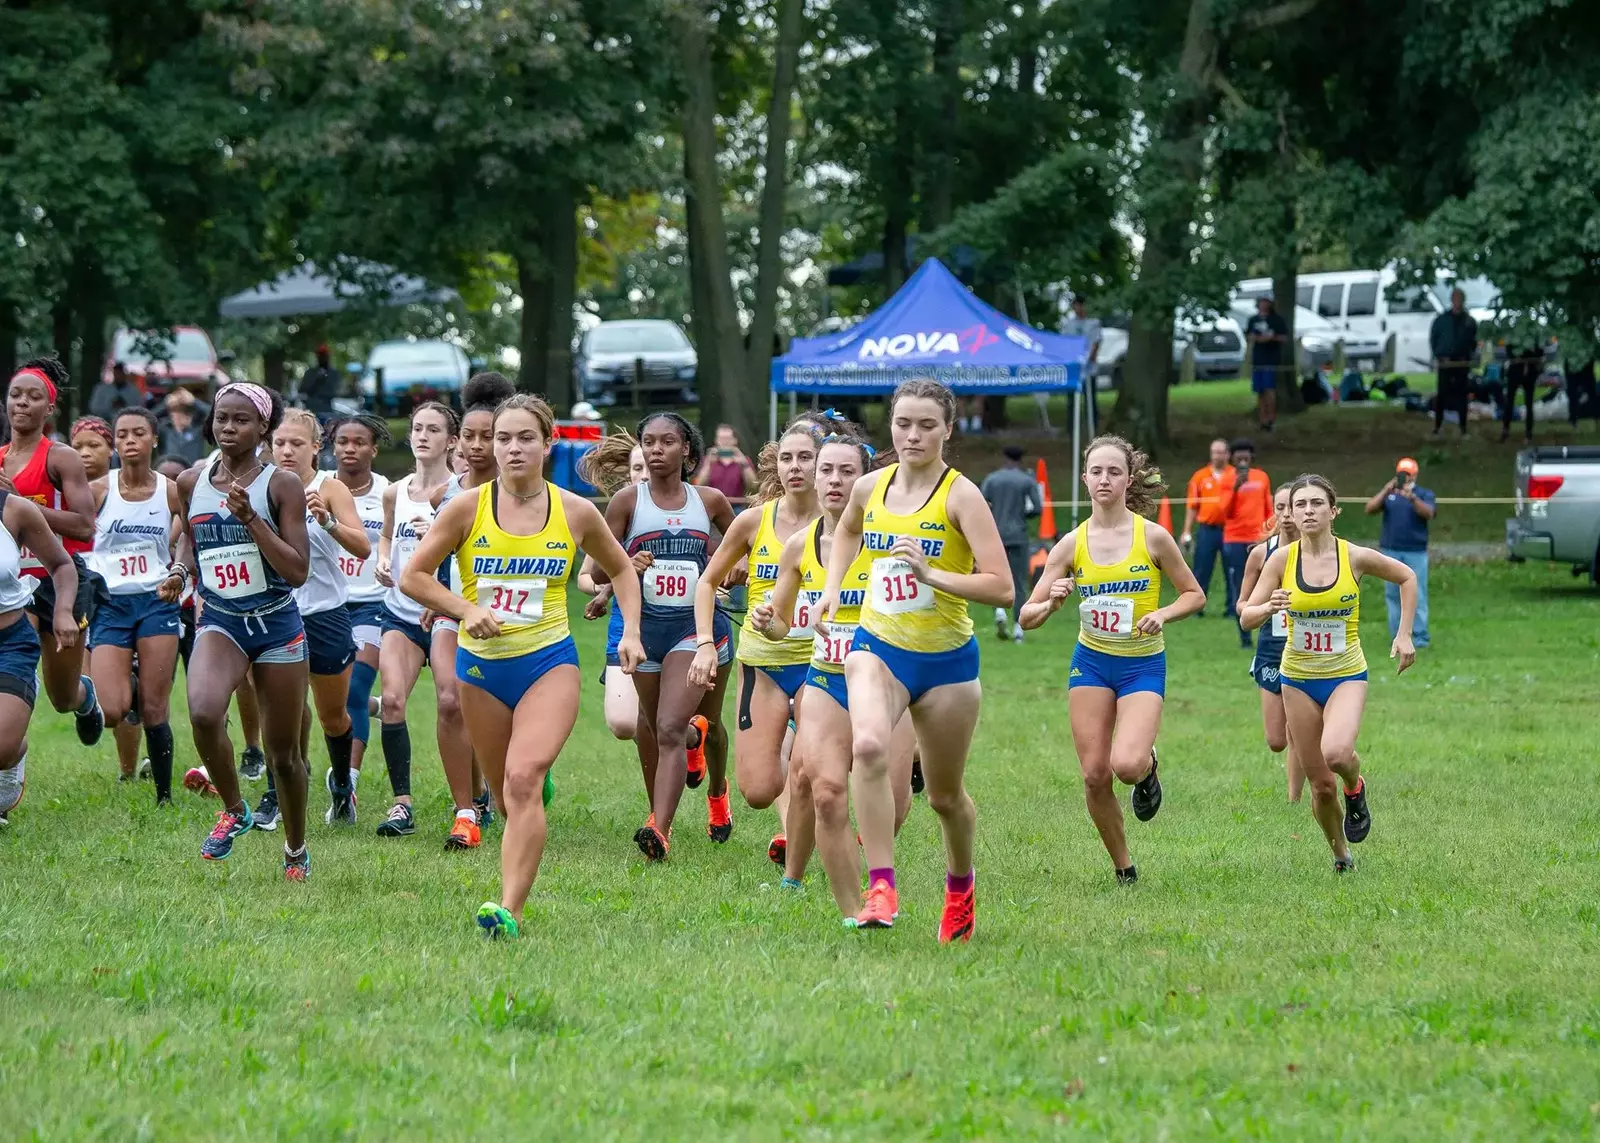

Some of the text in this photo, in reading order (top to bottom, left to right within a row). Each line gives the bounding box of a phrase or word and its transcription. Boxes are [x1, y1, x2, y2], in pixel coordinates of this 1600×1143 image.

[859, 331, 960, 360] NOVA
[107, 519, 165, 535] Neumann
[920, 521, 946, 532] CAA
[546, 541, 569, 550] CAA
[864, 532, 943, 557] DELARE
[119, 555, 148, 577] 370
[214, 561, 250, 589] 594
[473, 557, 567, 576] DELAWARE
[1129, 565, 1150, 573] CAA
[655, 575, 687, 597] 589
[882, 573, 918, 602] 315
[491, 586, 529, 614] 317
[831, 625, 842, 633] Fall
[1090, 609, 1120, 633] 312
[1304, 632, 1333, 652] 311
